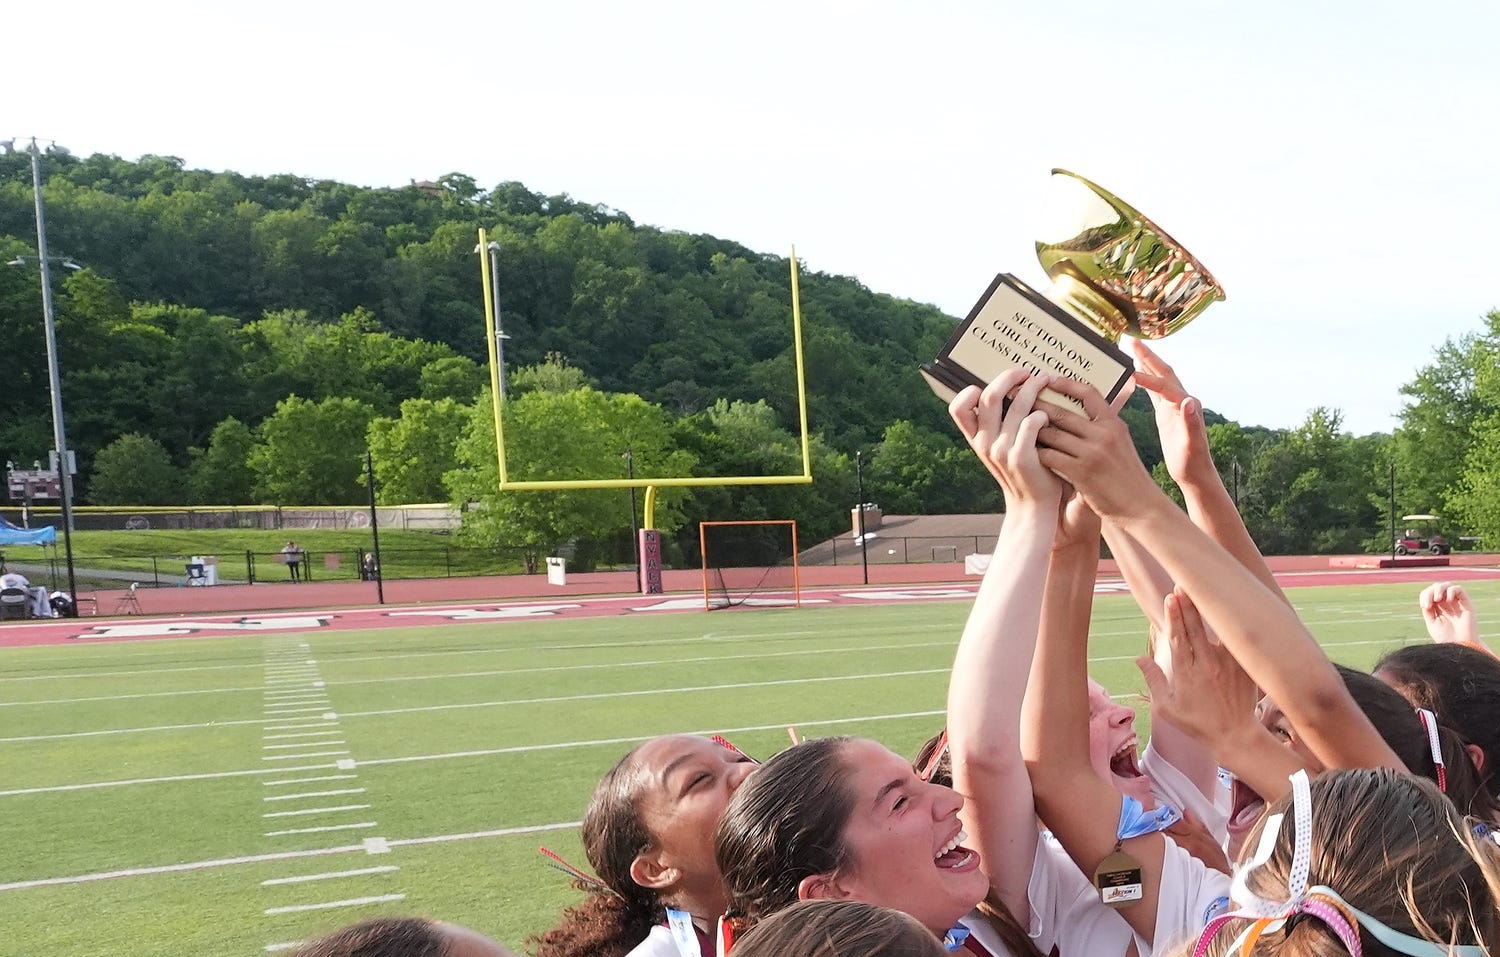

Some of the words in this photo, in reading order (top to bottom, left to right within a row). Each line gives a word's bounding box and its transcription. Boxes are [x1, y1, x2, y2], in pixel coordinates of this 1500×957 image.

[972, 326, 1011, 356] CLASS
[1011, 353, 1022, 363] B
[993, 319, 1032, 349] GIRLS
[1012, 311, 1067, 353] SECTION
[1066, 349, 1094, 372] ONE
[645, 531, 659, 595] NYACK
